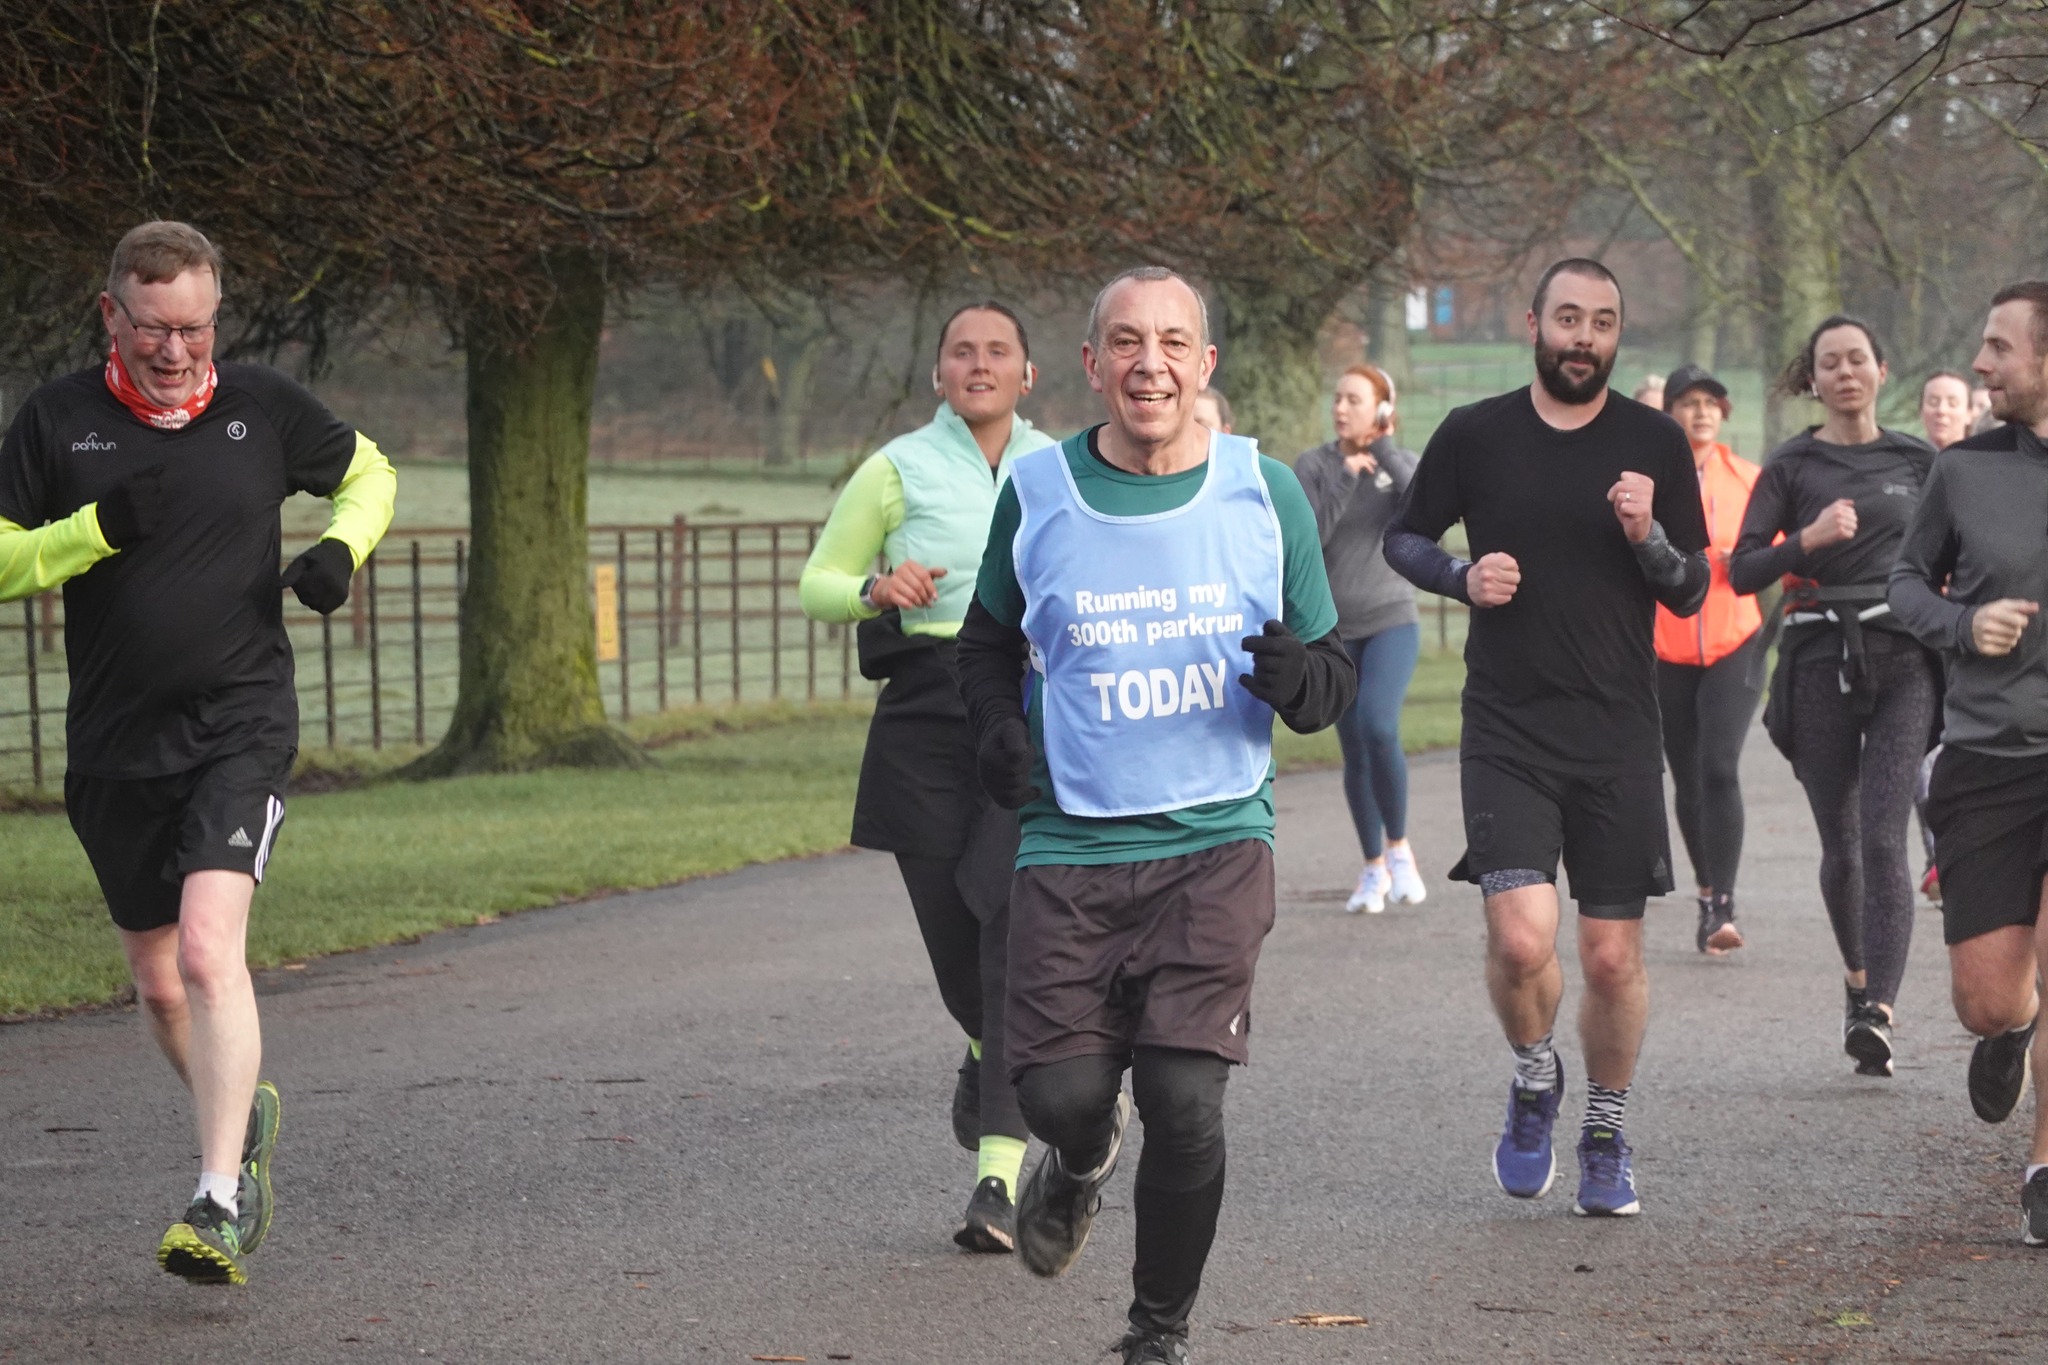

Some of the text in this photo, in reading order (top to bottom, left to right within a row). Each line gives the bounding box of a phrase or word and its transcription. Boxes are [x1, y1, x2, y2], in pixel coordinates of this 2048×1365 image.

[72, 432, 117, 452] parkrun
[1076, 583, 1227, 614] Running my
[1067, 612, 1243, 647] 300th parkrun
[1091, 658, 1226, 721] TODAY
